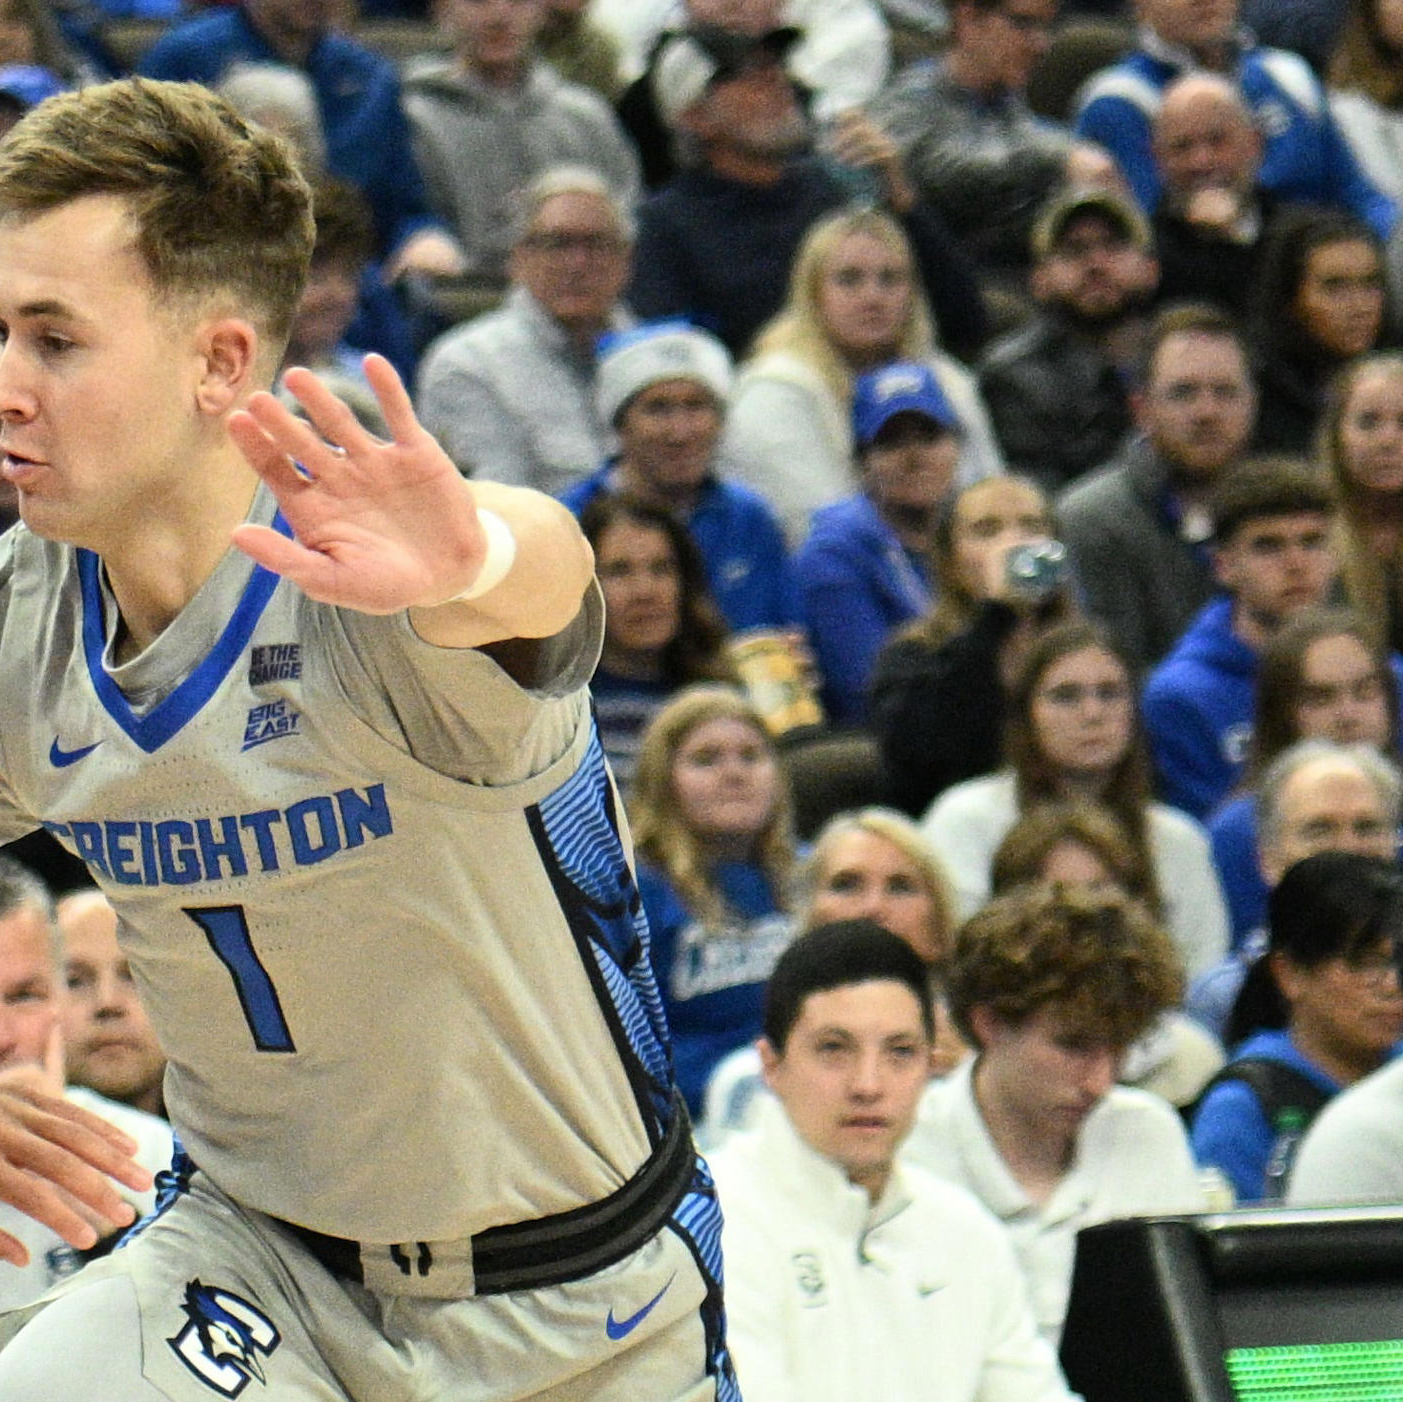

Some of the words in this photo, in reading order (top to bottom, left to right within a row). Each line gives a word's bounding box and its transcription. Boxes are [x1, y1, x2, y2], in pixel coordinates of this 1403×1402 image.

[268, 643, 301, 663] THE
[249, 698, 287, 720] BIG
[243, 713, 301, 742] EAST
[181, 903, 298, 1054] 1
